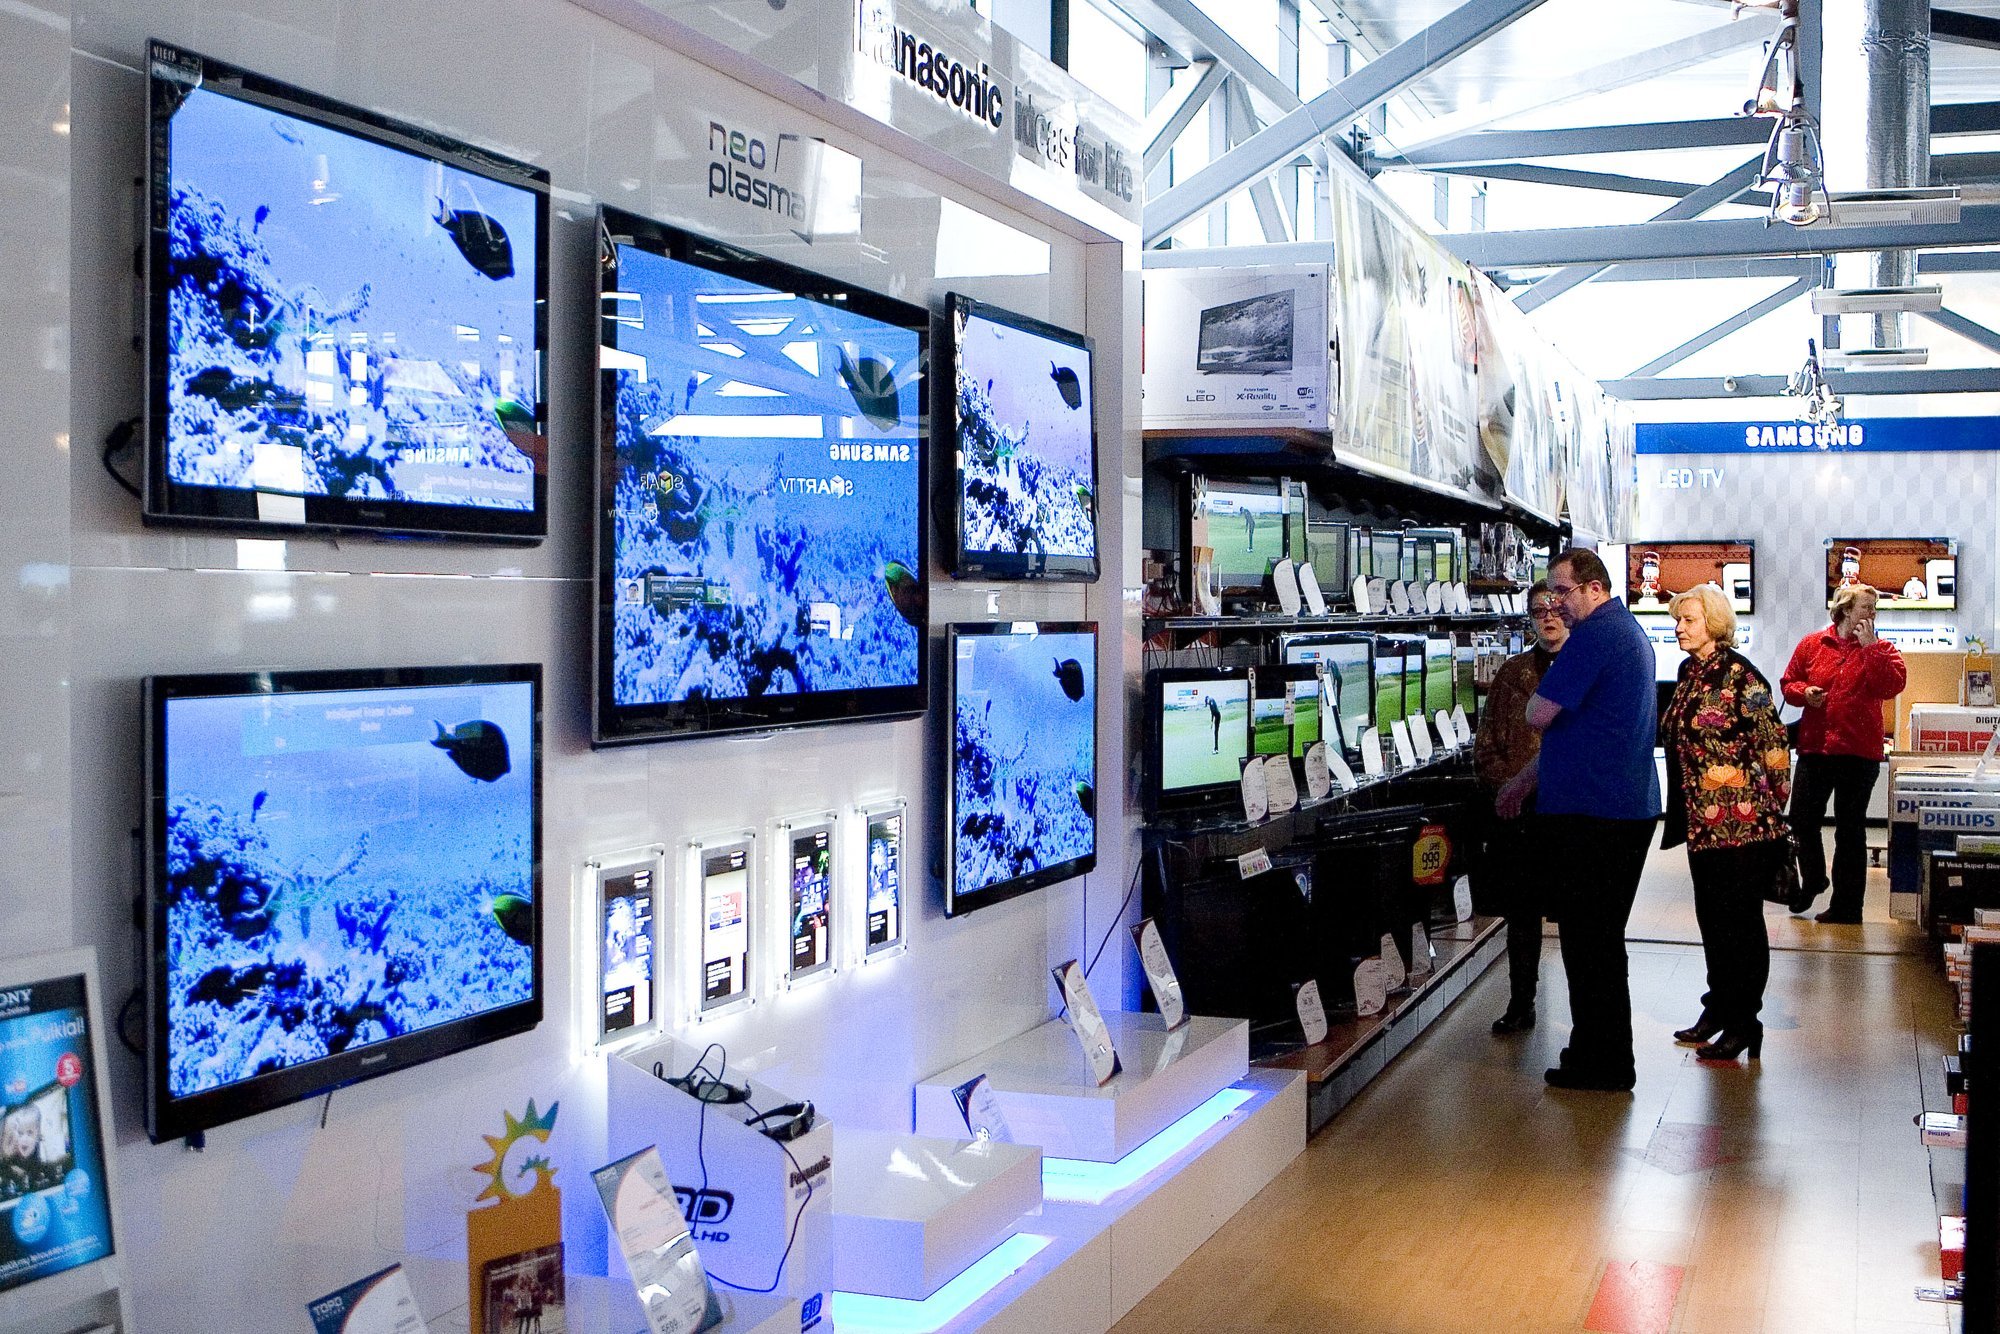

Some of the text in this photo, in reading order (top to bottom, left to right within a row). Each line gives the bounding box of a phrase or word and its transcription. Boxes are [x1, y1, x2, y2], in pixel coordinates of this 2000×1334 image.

[709, 121, 766, 170] neo
[1105, 141, 1133, 203] life
[709, 161, 806, 222] plasma
[1745, 425, 1863, 447] SAMSUNG
[1657, 468, 1724, 488] LED TV
[1924, 812, 1995, 828] PHILIPS
[1422, 851, 1440, 871] 999
[0, 987, 32, 1005] ONY
[701, 1230, 731, 1243] HD
